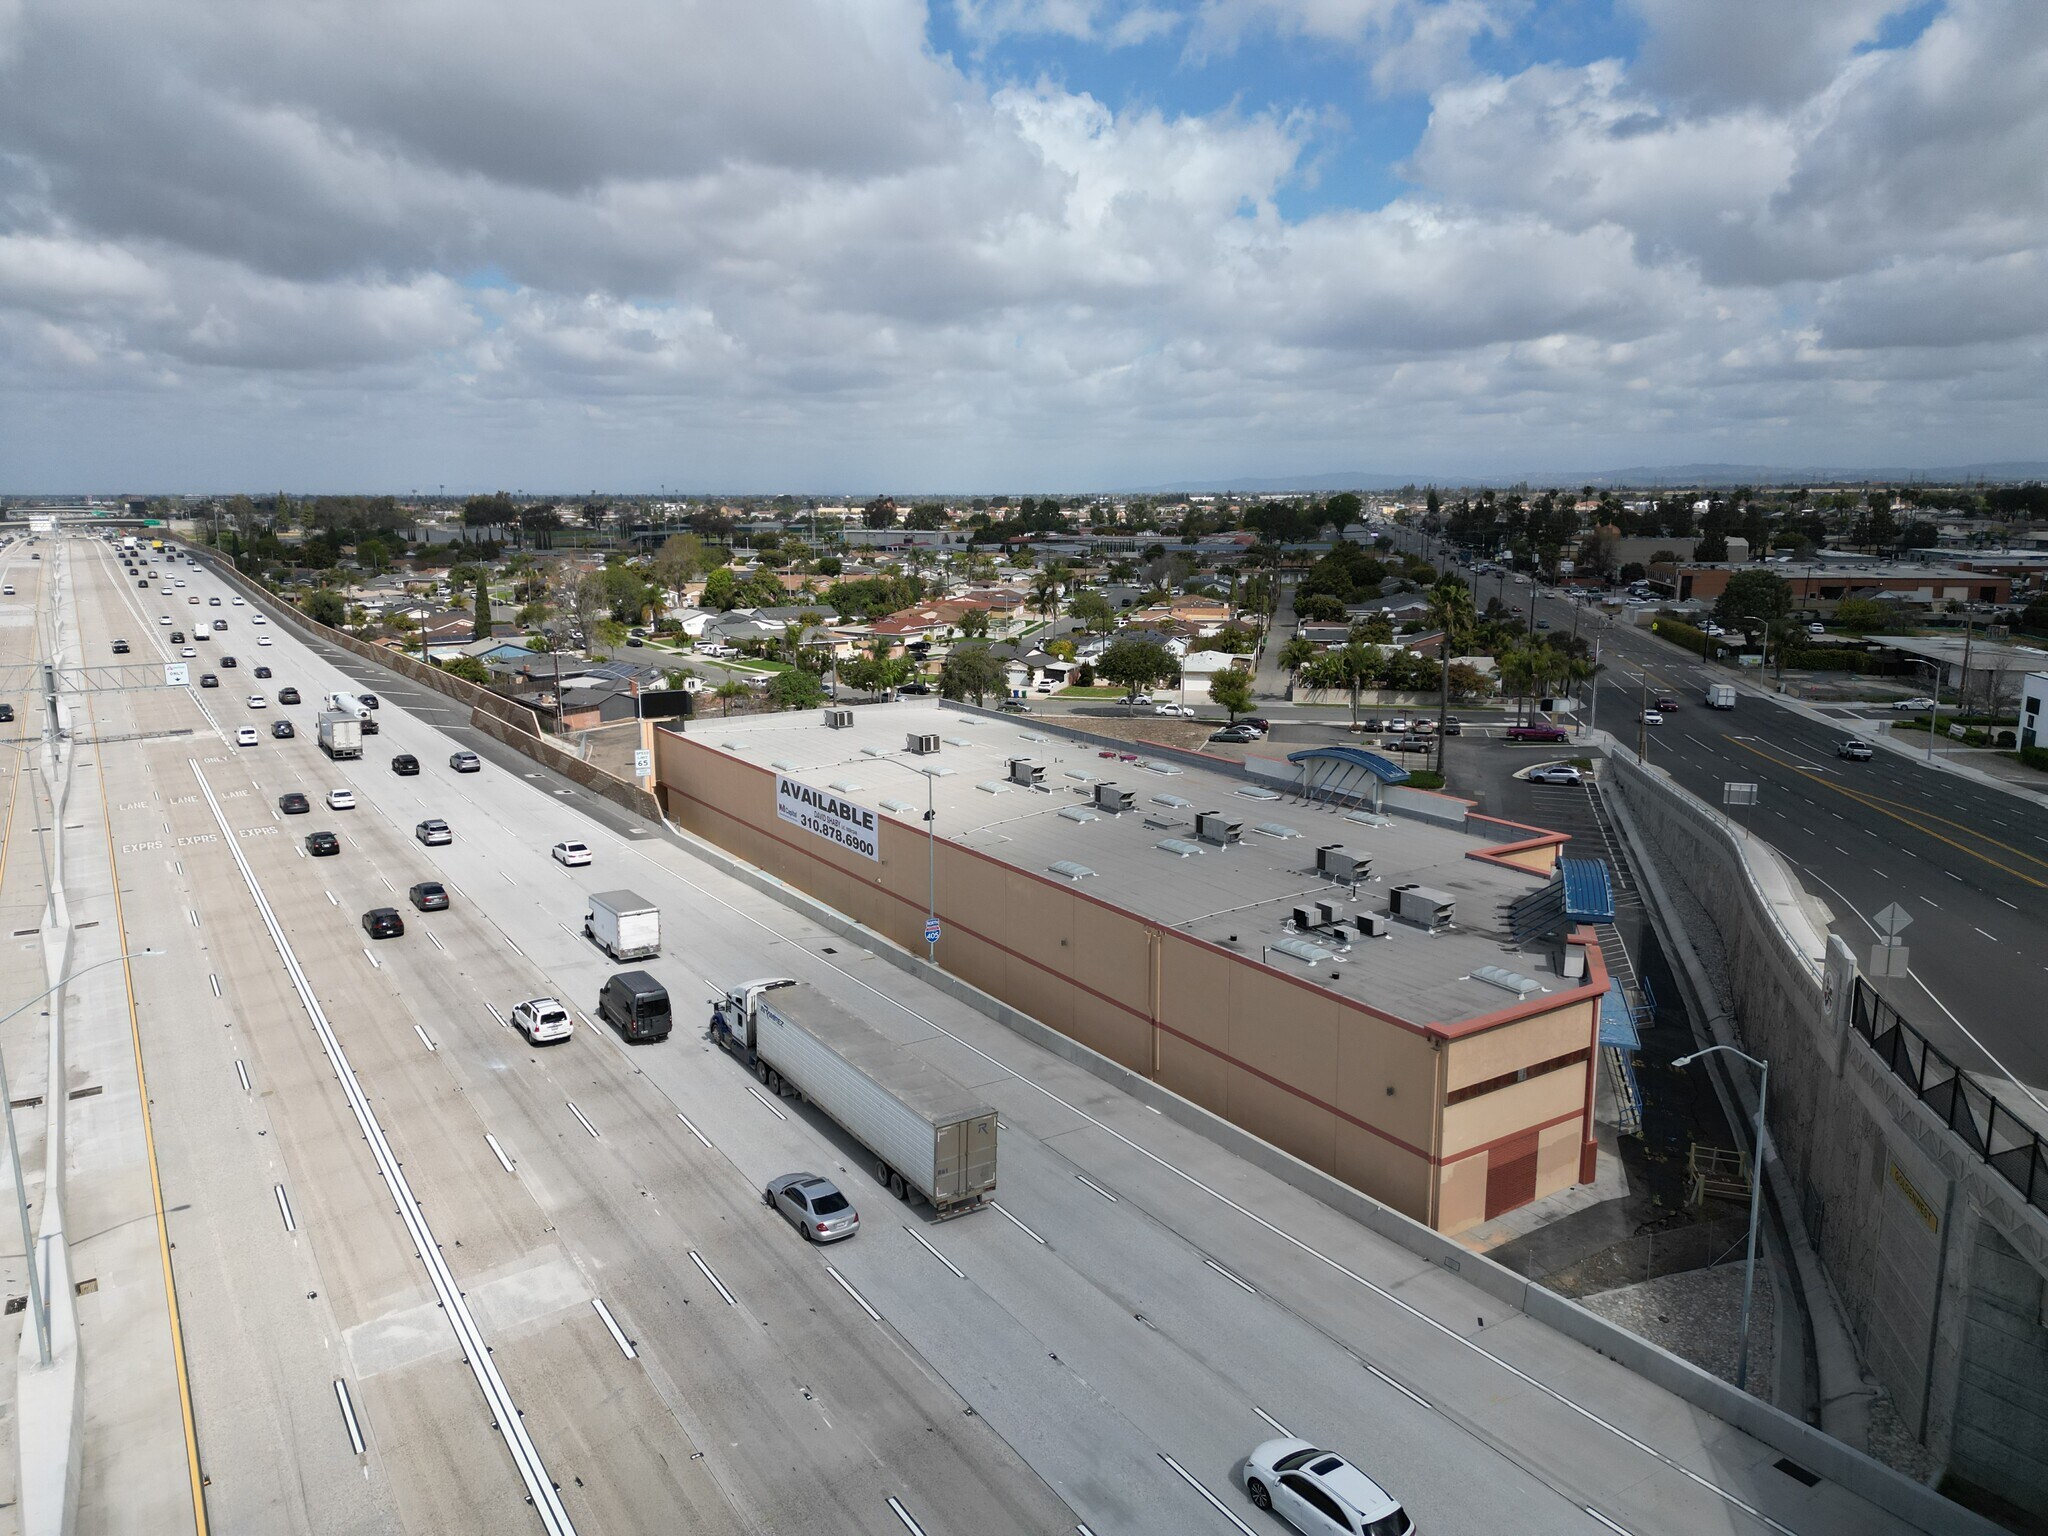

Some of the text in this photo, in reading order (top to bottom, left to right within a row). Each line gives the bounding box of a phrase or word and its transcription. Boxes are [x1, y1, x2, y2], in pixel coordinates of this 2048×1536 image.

[119, 789, 250, 811] LANE LANE LANE
[780, 779, 874, 832] AVAILABLE
[813, 810, 827, 822] DAVID
[122, 826, 279, 854] EXPRS EXPRS EXPRS
[800, 814, 874, 857] 310.878.6900
[926, 931, 939, 940] 405
[1894, 1171, 1932, 1224] GOLDENWEST
